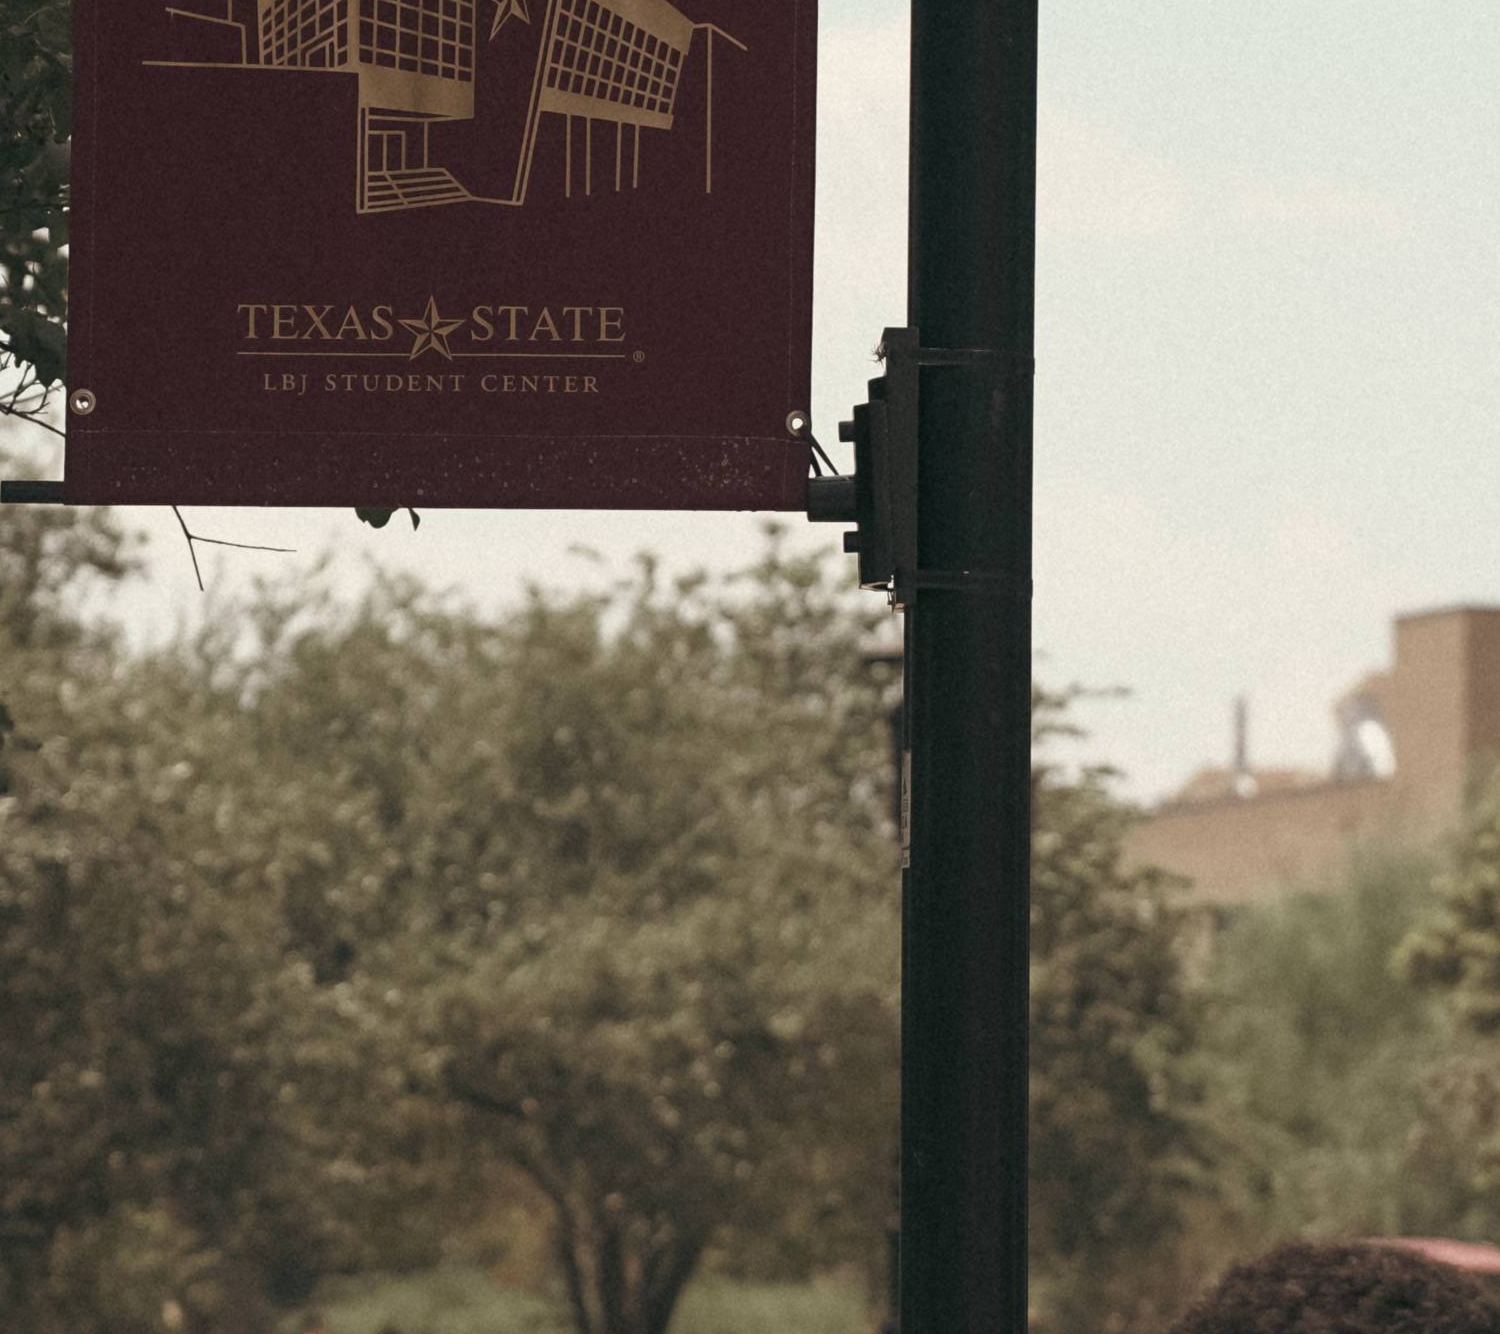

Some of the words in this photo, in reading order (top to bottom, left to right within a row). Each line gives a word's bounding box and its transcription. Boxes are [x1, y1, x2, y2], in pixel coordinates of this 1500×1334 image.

[236, 303, 394, 341] TEXAS
[470, 304, 627, 342] STATE
[263, 373, 308, 396] LBJ
[324, 373, 466, 392] STUDENT
[480, 374, 600, 394] CENTER
